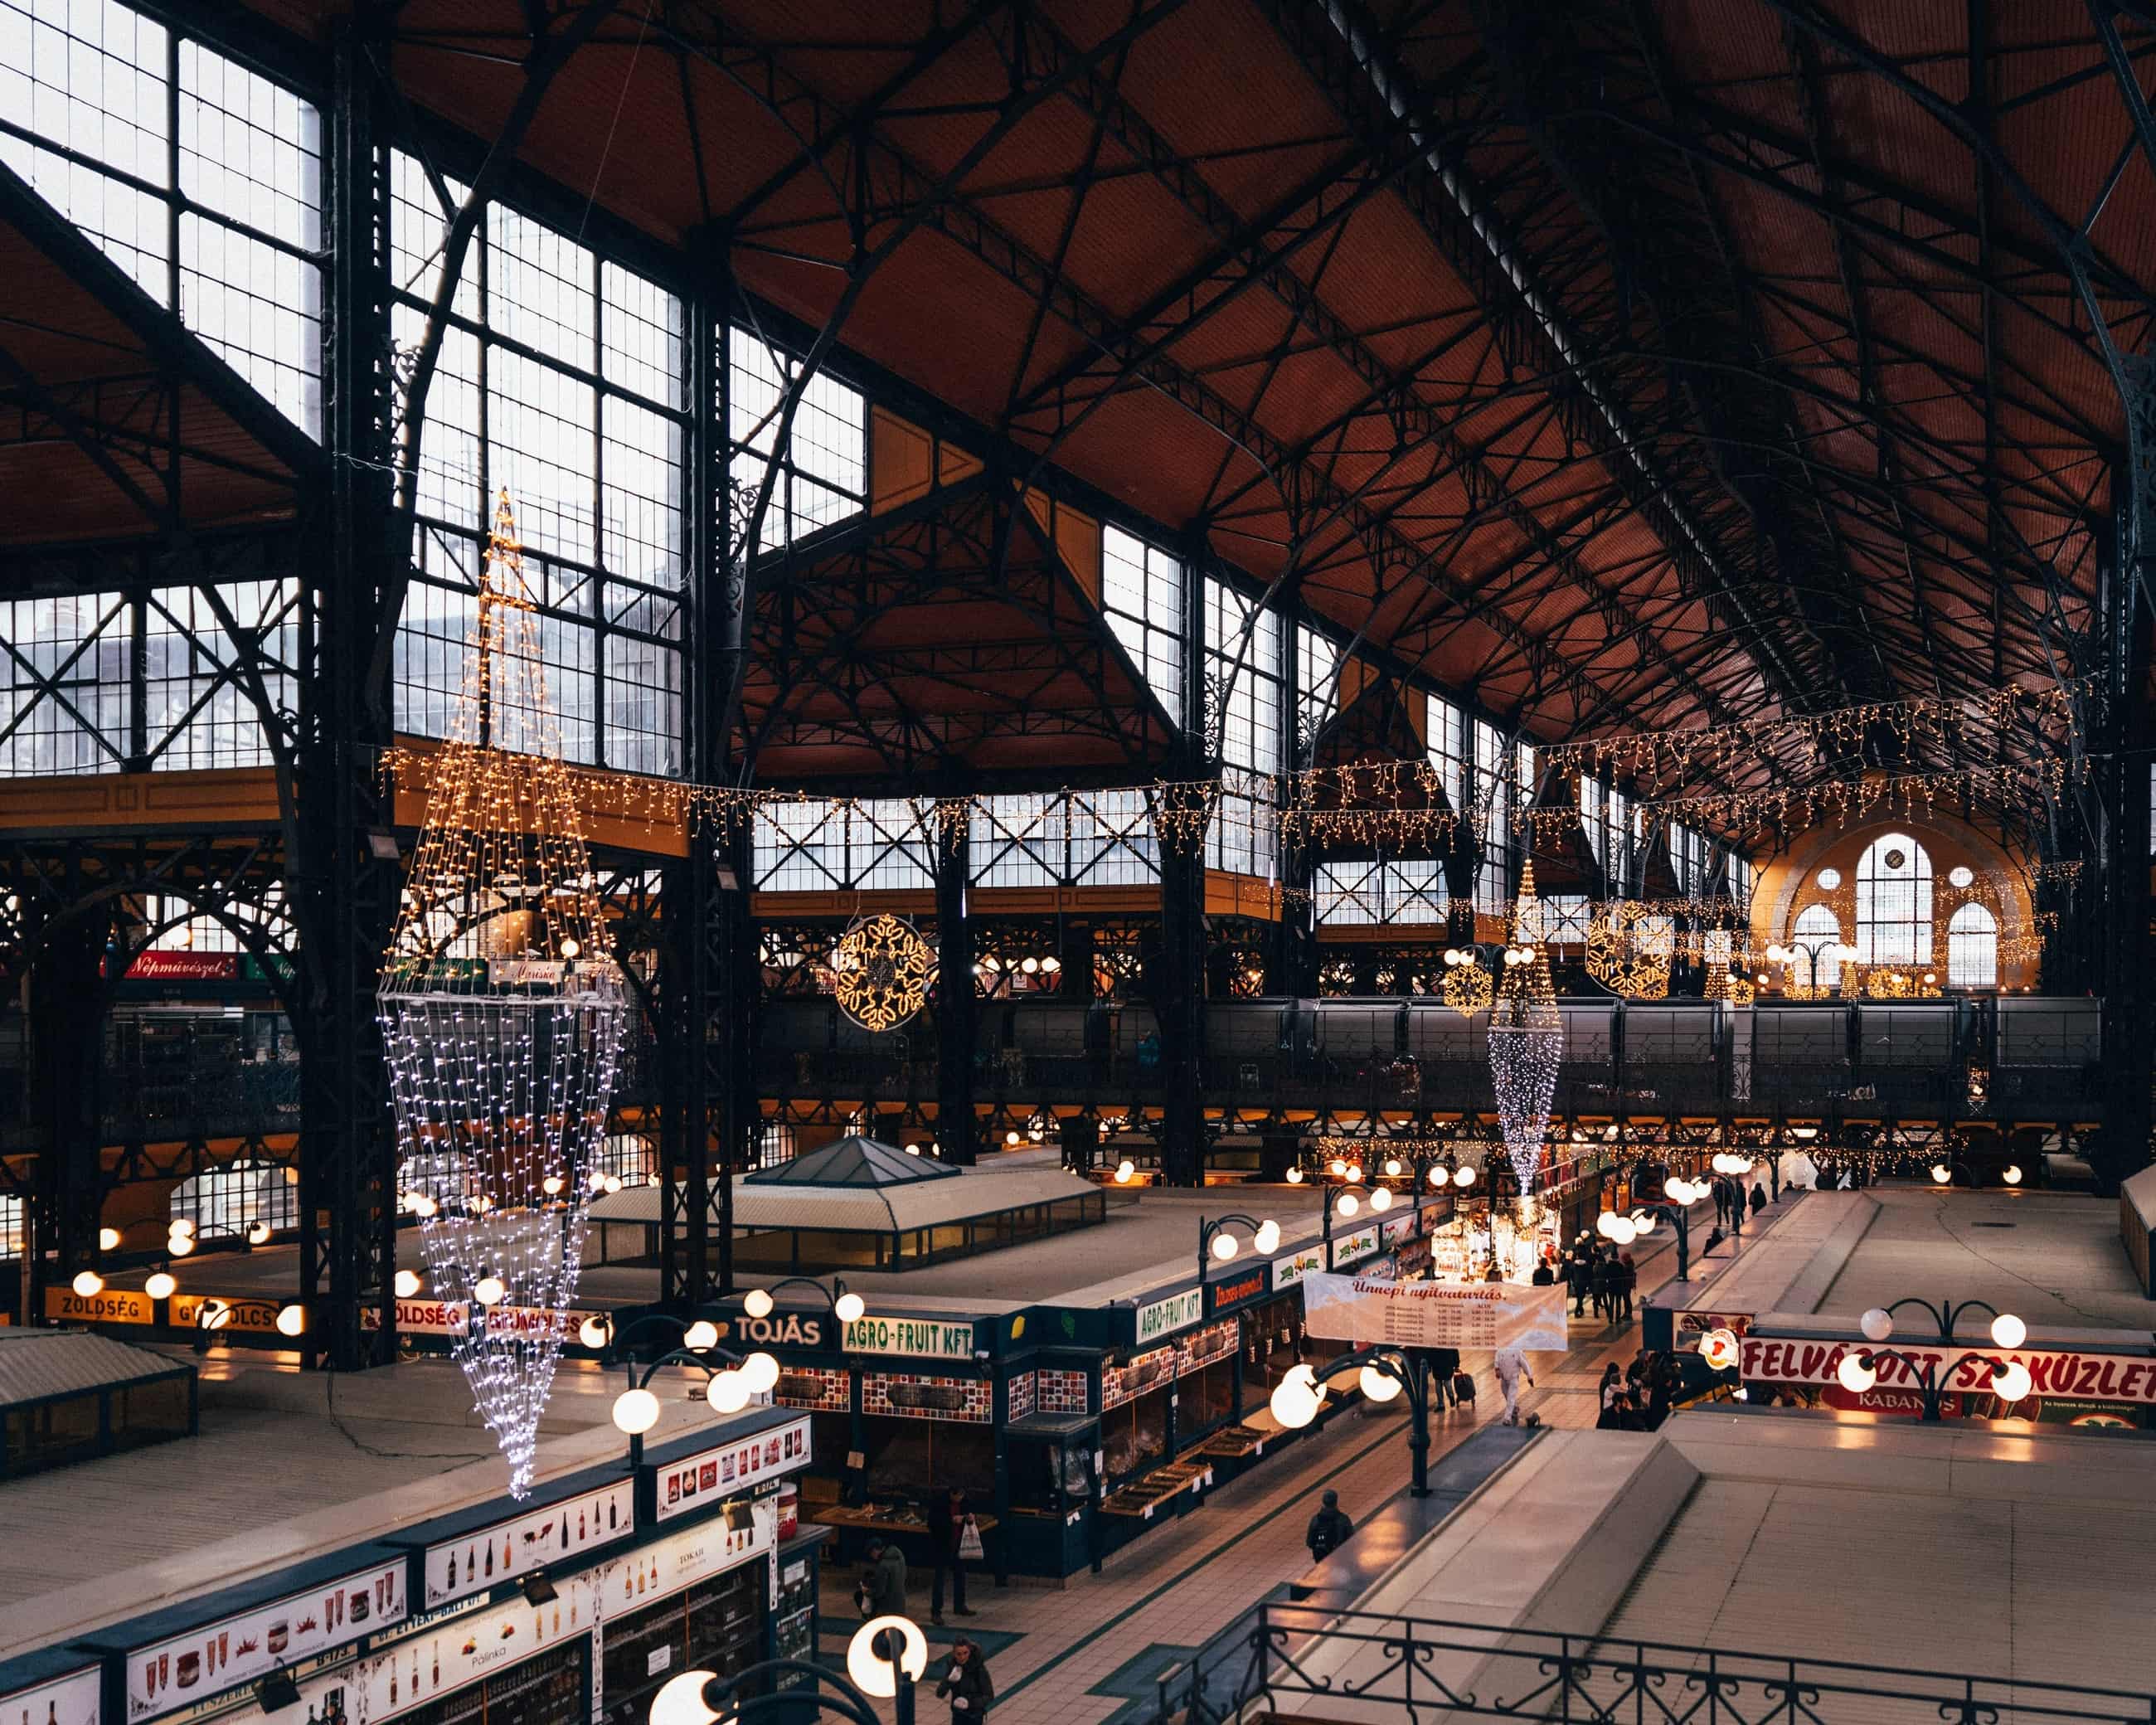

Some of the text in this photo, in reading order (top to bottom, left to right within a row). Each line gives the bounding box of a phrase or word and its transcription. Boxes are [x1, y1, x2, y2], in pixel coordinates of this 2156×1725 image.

[1352, 1277, 1407, 1300] Ünnepi
[396, 1303, 460, 1325] ÖLDSÉG
[1141, 1297, 1185, 1338] AGRO-FRUIT
[735, 1314, 821, 1345] TOJÁS
[847, 1319, 974, 1355] AGRO-FRUIT KFT.
[1742, 1341, 2156, 1399] FELVÁOTT SZKÜZLET
[1859, 1392, 1956, 1412] KABANS
[471, 1645, 507, 1669] Pálinka
